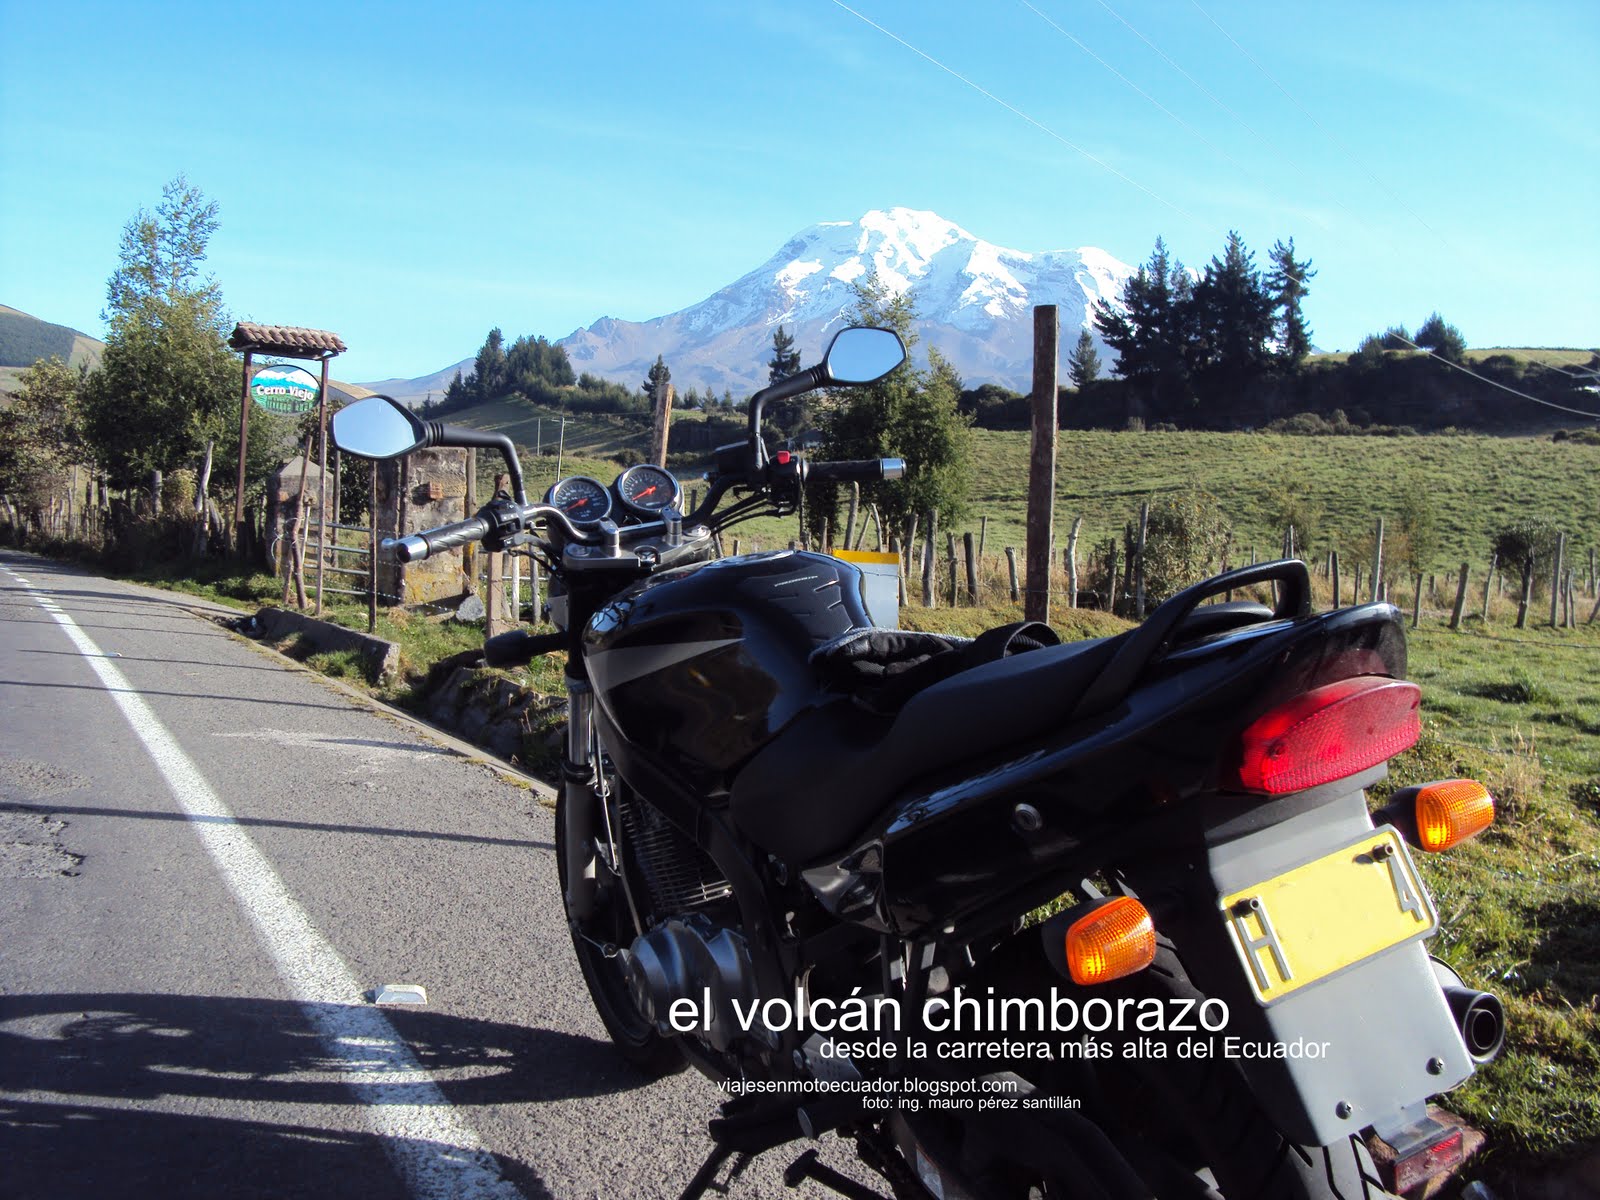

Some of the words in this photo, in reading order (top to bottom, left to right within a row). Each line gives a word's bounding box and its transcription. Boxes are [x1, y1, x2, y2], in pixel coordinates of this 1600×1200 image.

[256, 386, 286, 396] Cerro
[289, 386, 314, 401] Viejo
[1227, 896, 1293, 991] H
